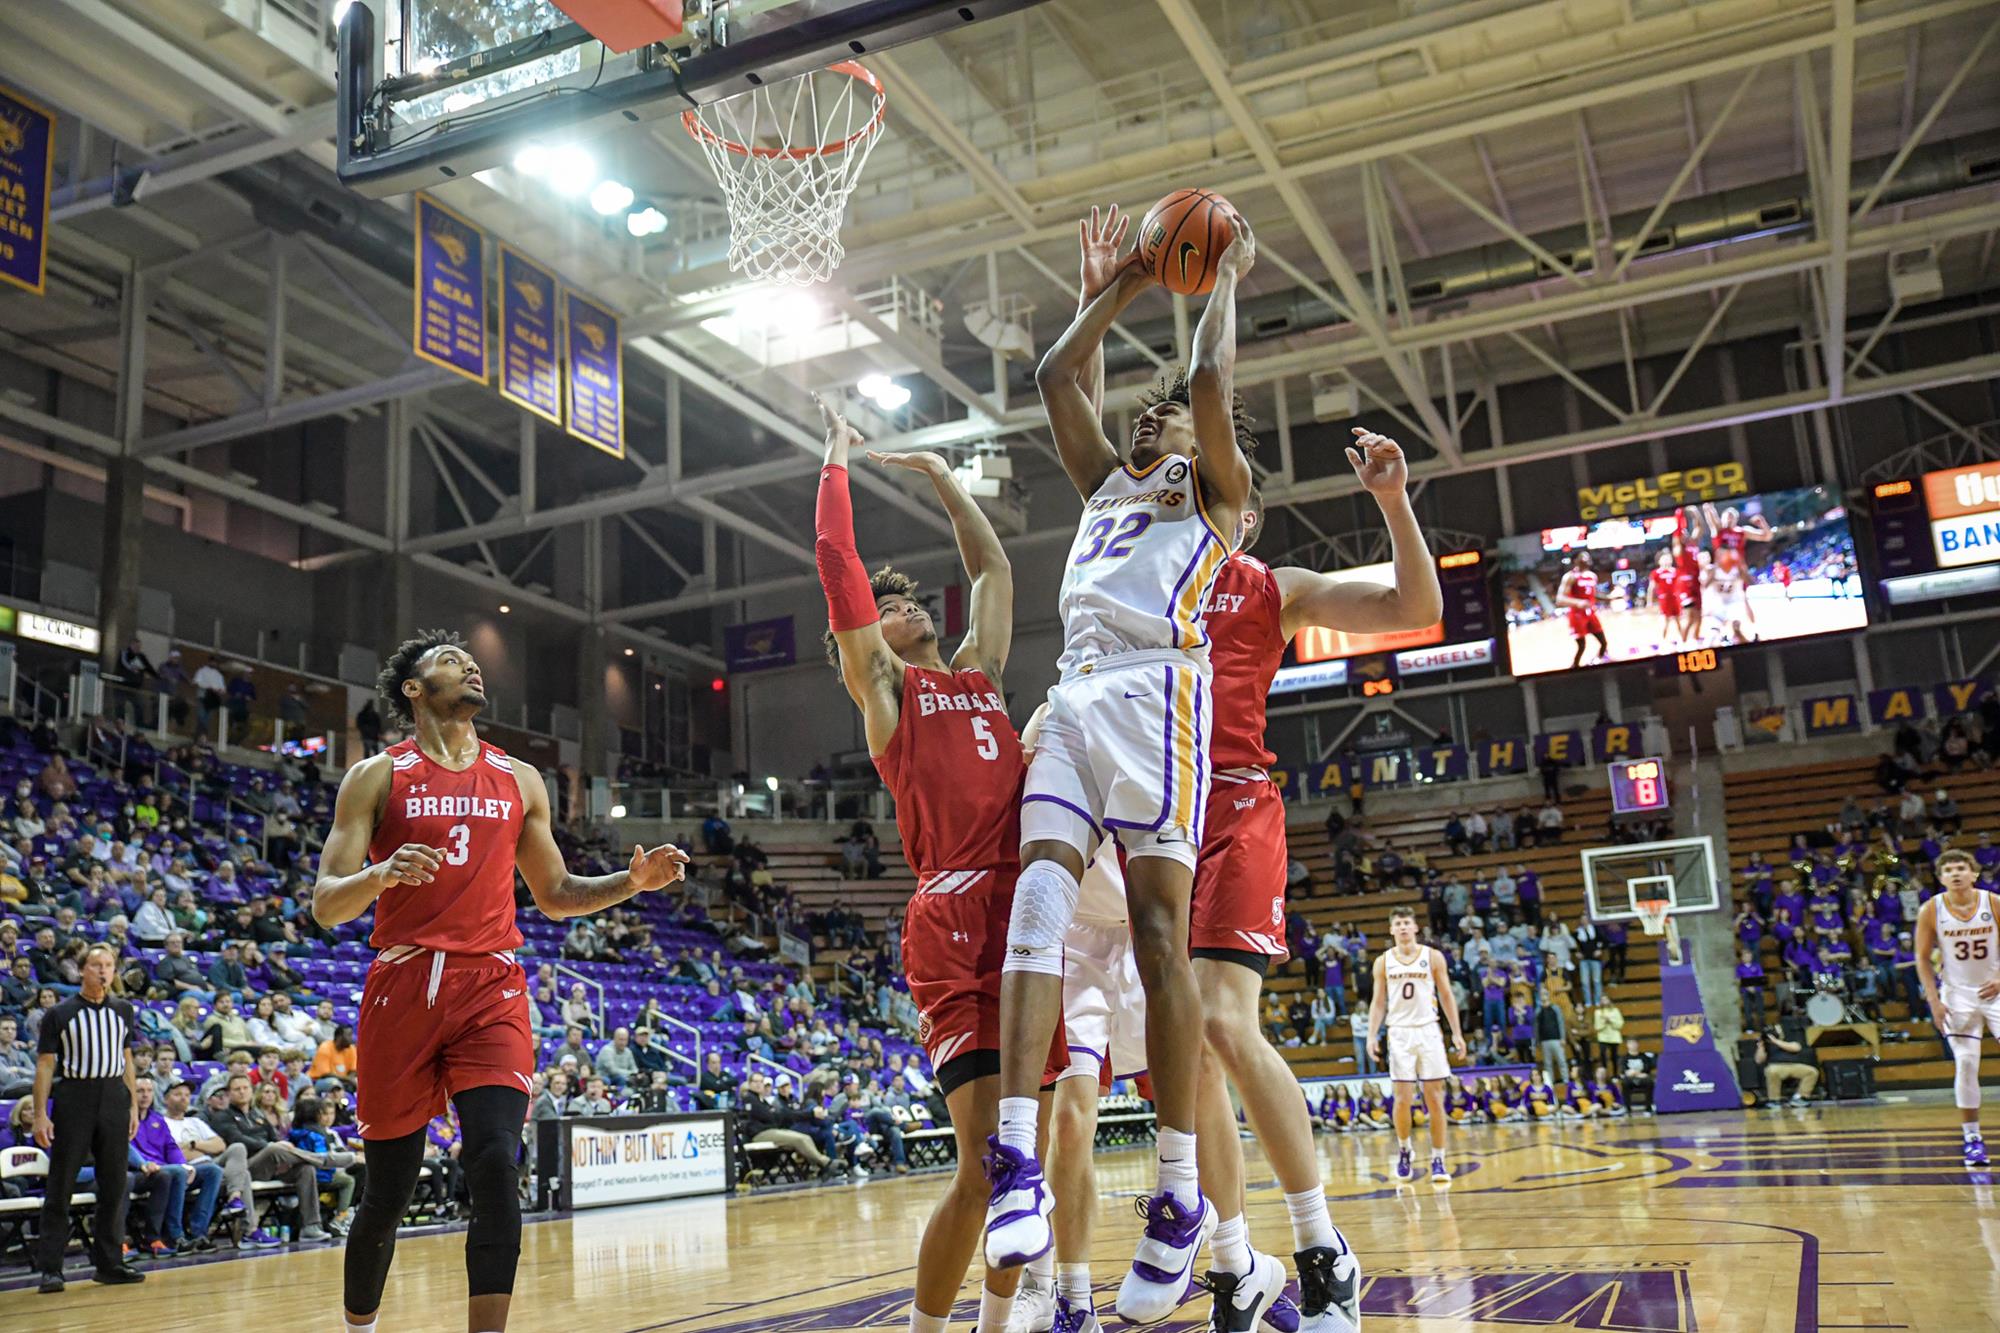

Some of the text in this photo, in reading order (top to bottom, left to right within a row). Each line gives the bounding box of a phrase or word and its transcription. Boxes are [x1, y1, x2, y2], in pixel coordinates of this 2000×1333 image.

[1075, 512, 1152, 566] 32
[1400, 647, 1487, 670] SCHEELS
[1678, 649, 1717, 673] 1:00
[970, 716, 999, 760] 5
[405, 796, 512, 820] BRADLEY
[446, 824, 470, 865] 3
[1944, 926, 1993, 937] PANTHERS
[1954, 939, 1989, 960] 35
[1402, 982, 1414, 1000] 0
[625, 1134, 647, 1162] BUT
[651, 1132, 677, 1160] NET.
